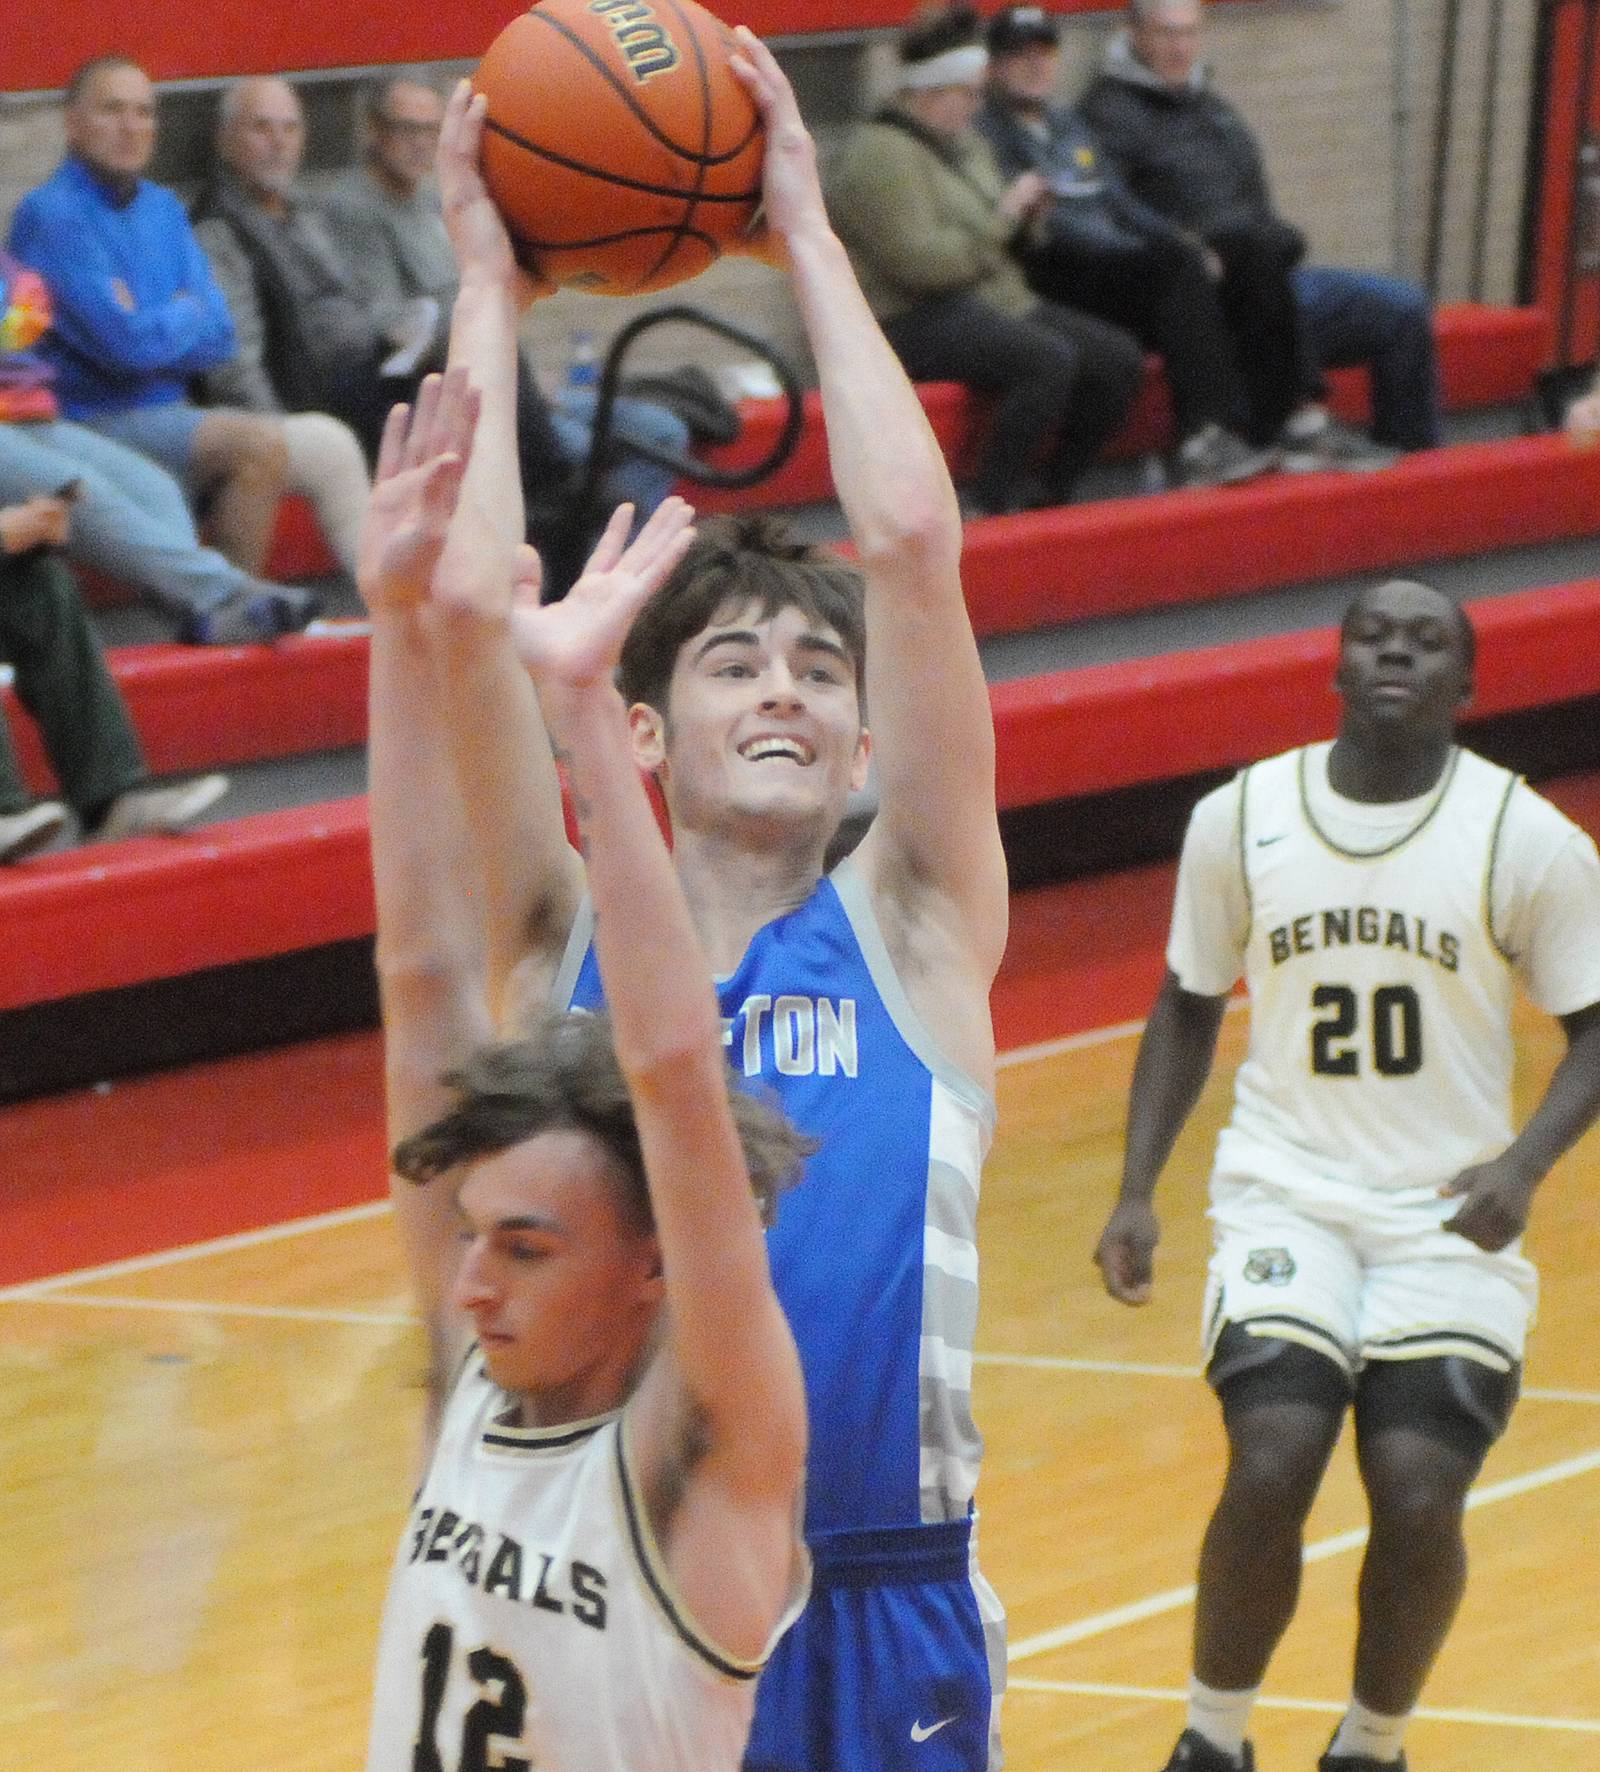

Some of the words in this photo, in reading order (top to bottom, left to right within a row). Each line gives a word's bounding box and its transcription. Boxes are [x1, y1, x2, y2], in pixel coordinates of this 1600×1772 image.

[1268, 905, 1460, 973] BENGALS
[1310, 983, 1422, 1077] 20
[412, 1621, 533, 1772] 12
